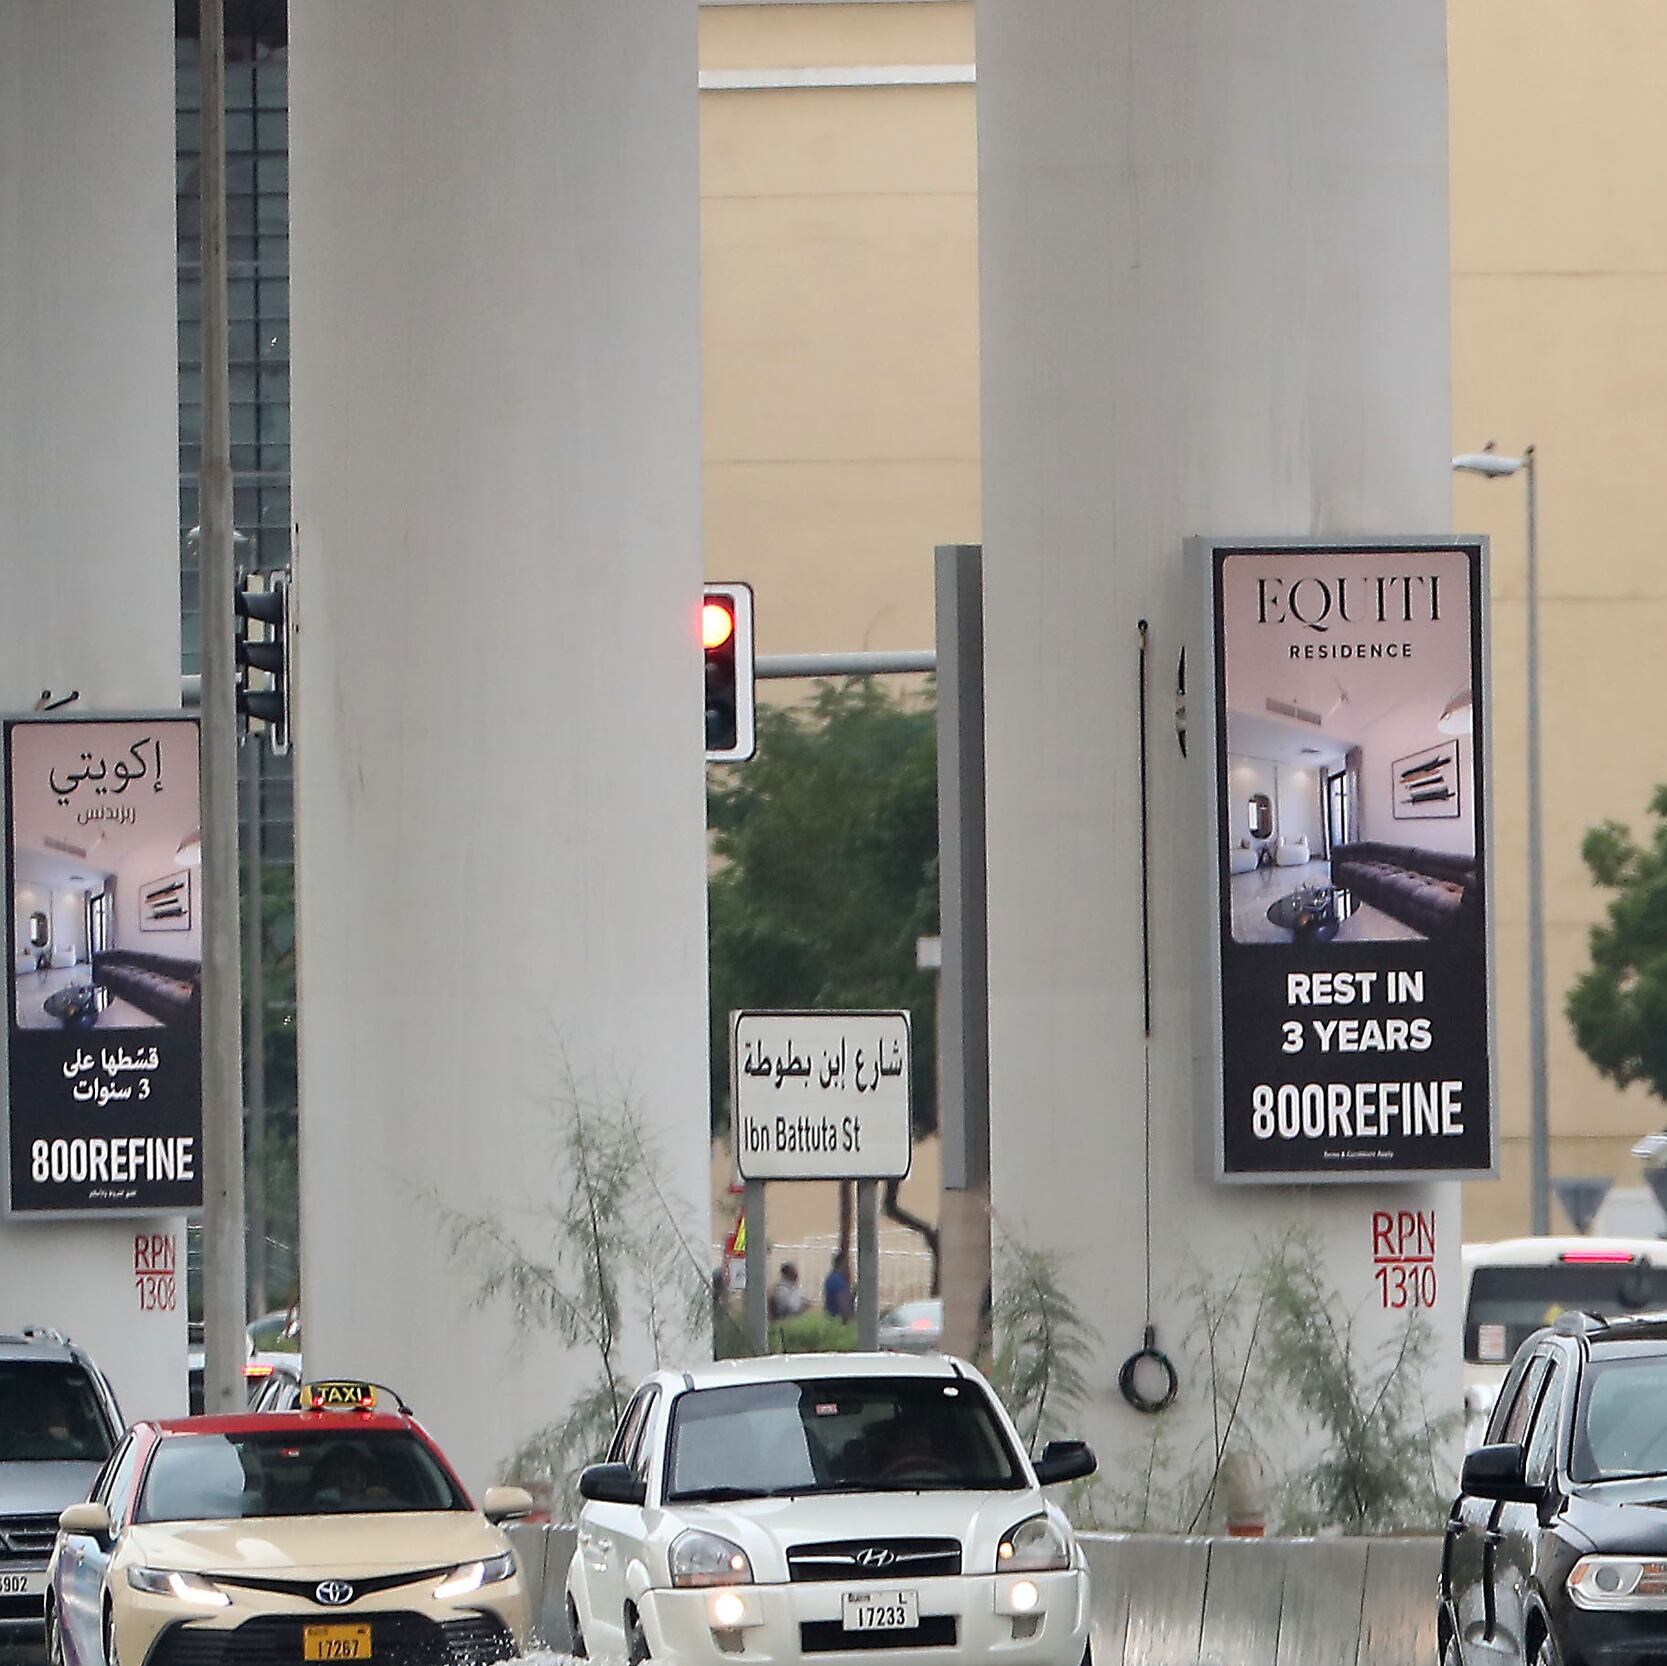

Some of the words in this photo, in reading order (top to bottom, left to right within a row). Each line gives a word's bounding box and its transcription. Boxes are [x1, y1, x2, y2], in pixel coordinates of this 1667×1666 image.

[1257, 576, 1440, 632] EQUITI
[1289, 643, 1413, 659] RESIDENCE
[50, 736, 164, 806] إكويتي
[1286, 972, 1377, 1005] REST
[1387, 970, 1424, 1003] IN
[1281, 1020, 1304, 1053] 3
[1312, 1017, 1433, 1052] YEARS
[63, 1048, 95, 1078] على
[744, 1039, 812, 1089] بطوطة
[855, 1037, 903, 1093] شارع
[73, 1077, 132, 1107] سنوات
[138, 1078, 151, 1100] 3
[1252, 1081, 1464, 1139] 800REFINE
[745, 1117, 770, 1151] Ibn
[776, 1116, 838, 1151] Battuta
[843, 1117, 861, 1152] St
[32, 1137, 194, 1183] 800REFINE
[1373, 1210, 1435, 1255] RPN
[135, 1234, 176, 1269] RPN
[135, 1276, 176, 1310] 1308
[1375, 1264, 1437, 1308] 1310
[318, 1387, 362, 1403] TAXI
[859, 1607, 905, 1627] 17233
[318, 1640, 358, 1657] 17267
